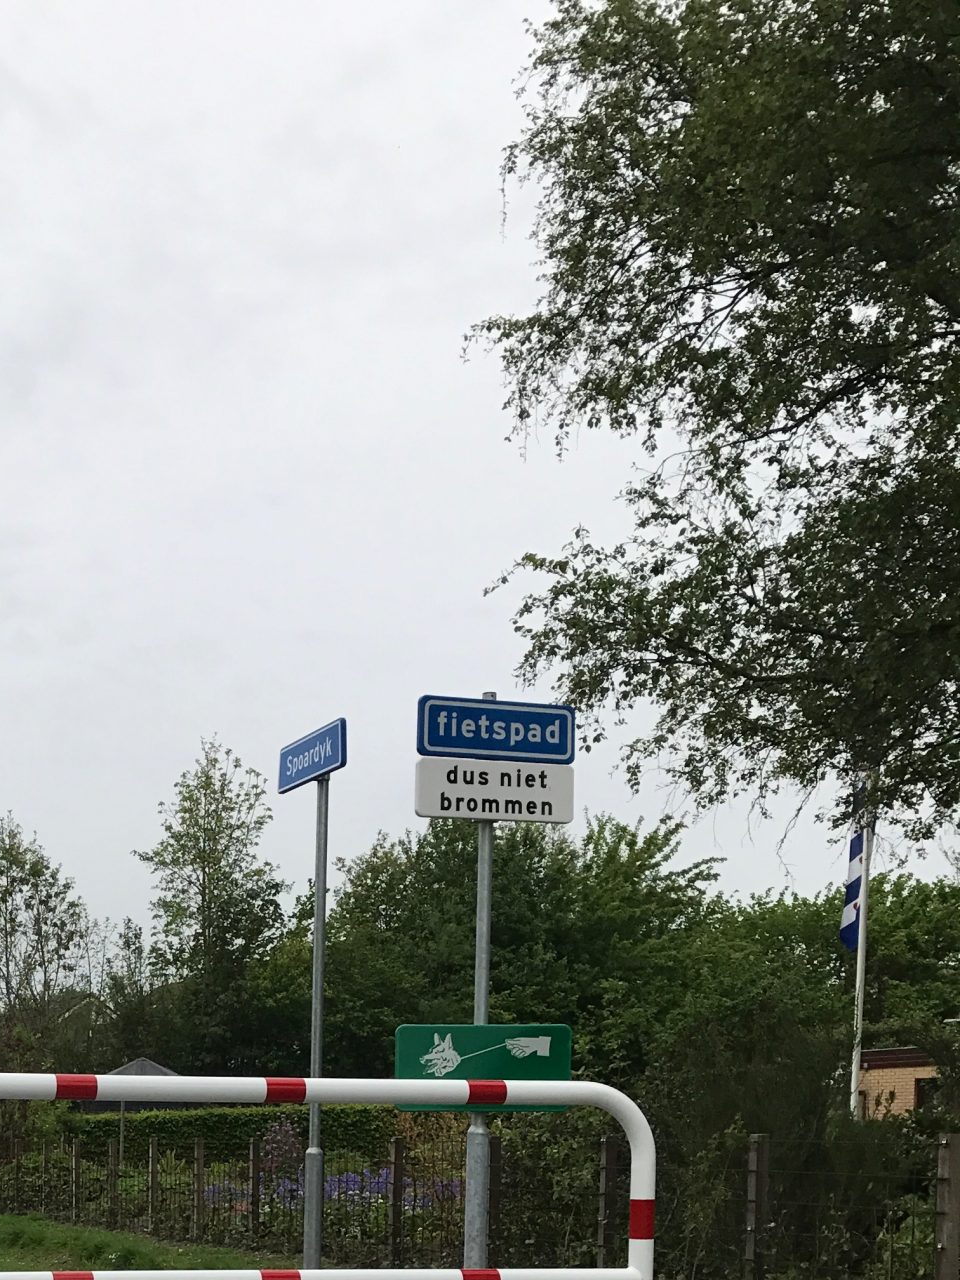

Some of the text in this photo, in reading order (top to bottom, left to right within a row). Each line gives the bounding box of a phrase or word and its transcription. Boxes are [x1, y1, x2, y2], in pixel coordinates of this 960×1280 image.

[437, 711, 561, 745] fietspad
[286, 738, 333, 777] Spoardyk
[446, 765, 548, 789] dus niet
[440, 792, 553, 815] brommen
